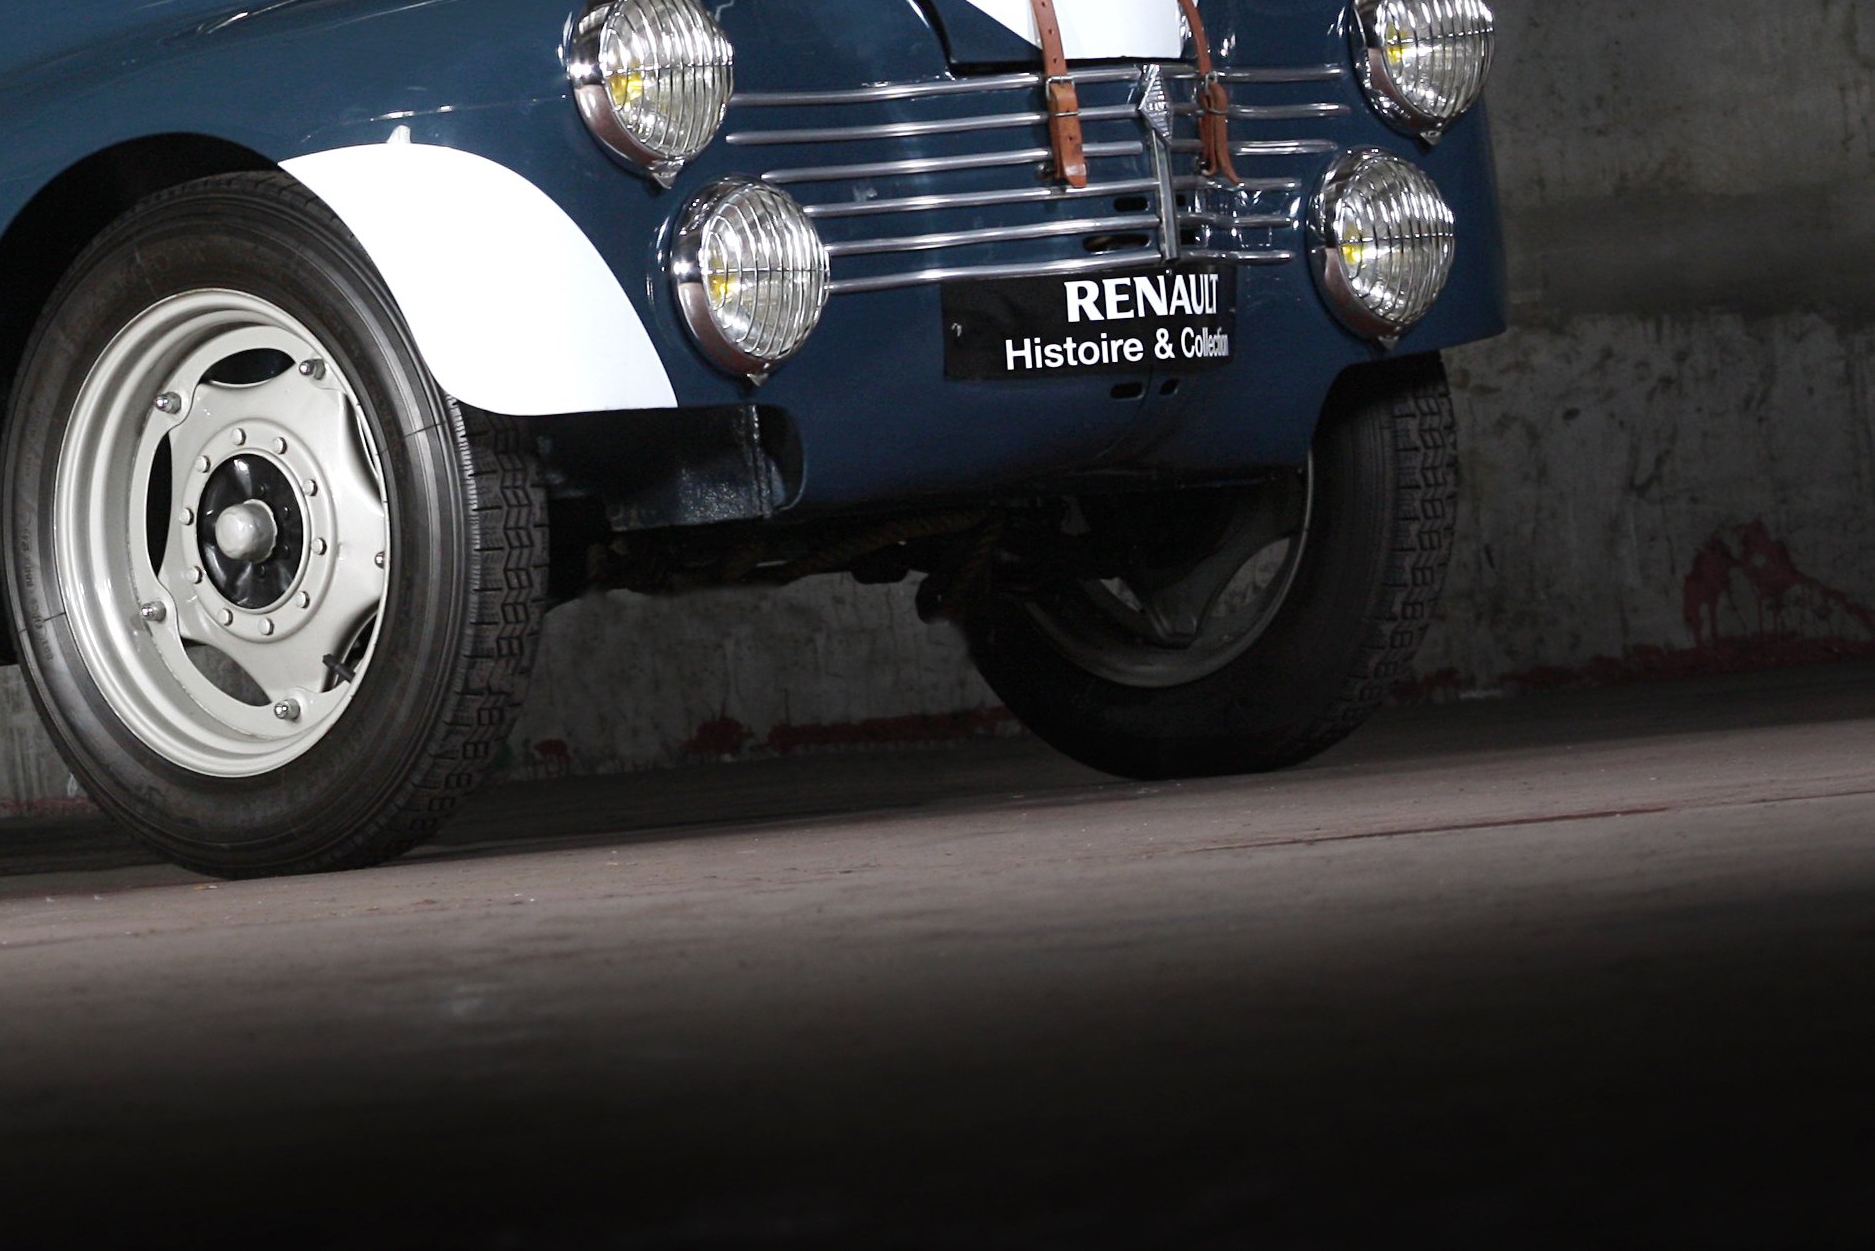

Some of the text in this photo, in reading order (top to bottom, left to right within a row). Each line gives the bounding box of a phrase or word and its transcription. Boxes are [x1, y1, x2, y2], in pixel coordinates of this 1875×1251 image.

[1063, 273, 1219, 323] RENAULT
[1005, 333, 1144, 370] Histoire
[1154, 327, 1175, 360] &
